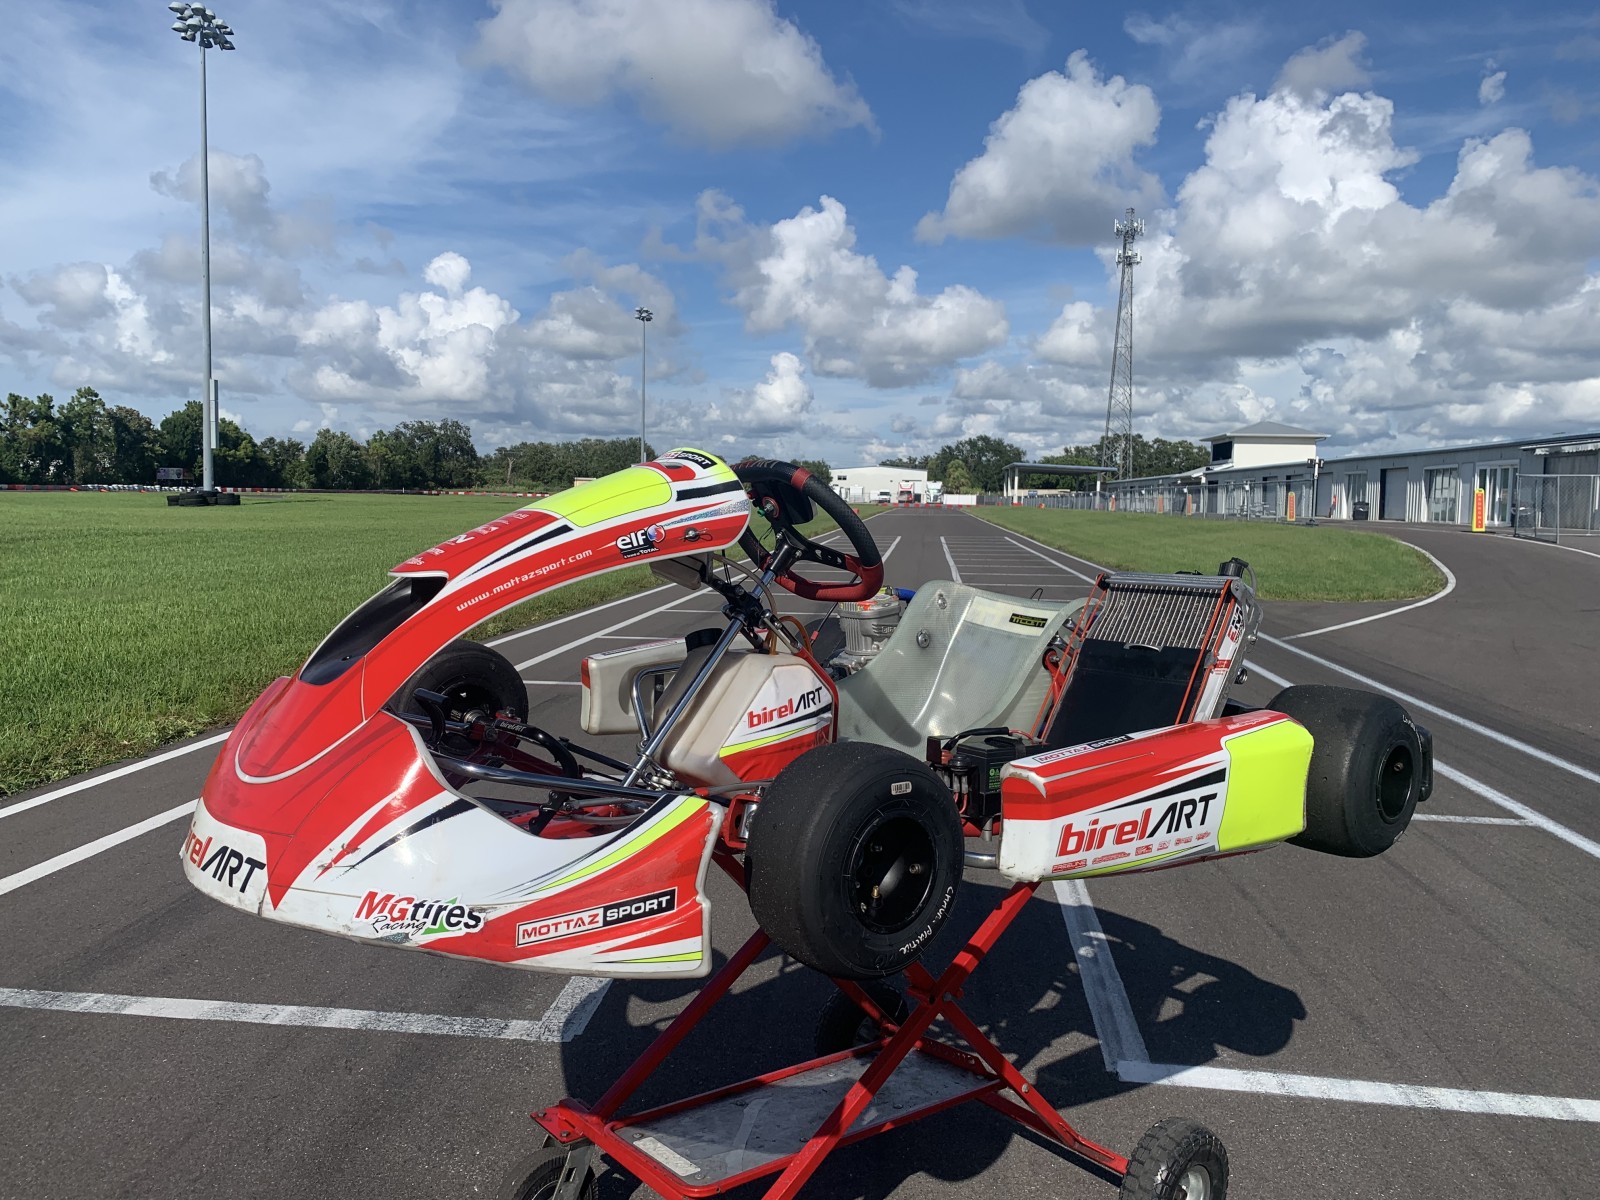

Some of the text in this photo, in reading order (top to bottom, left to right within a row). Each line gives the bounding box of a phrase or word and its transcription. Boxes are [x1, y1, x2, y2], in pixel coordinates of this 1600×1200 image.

[616, 529, 646, 550] elf
[456, 549, 593, 612] www.mottazsport.com
[748, 686, 823, 728] birelART
[1039, 735, 1128, 762] MOTTAZ SPORT
[1056, 792, 1218, 857] birelART
[371, 915, 427, 936] Racing
[522, 895, 671, 940] MOTTAZ SPORT
